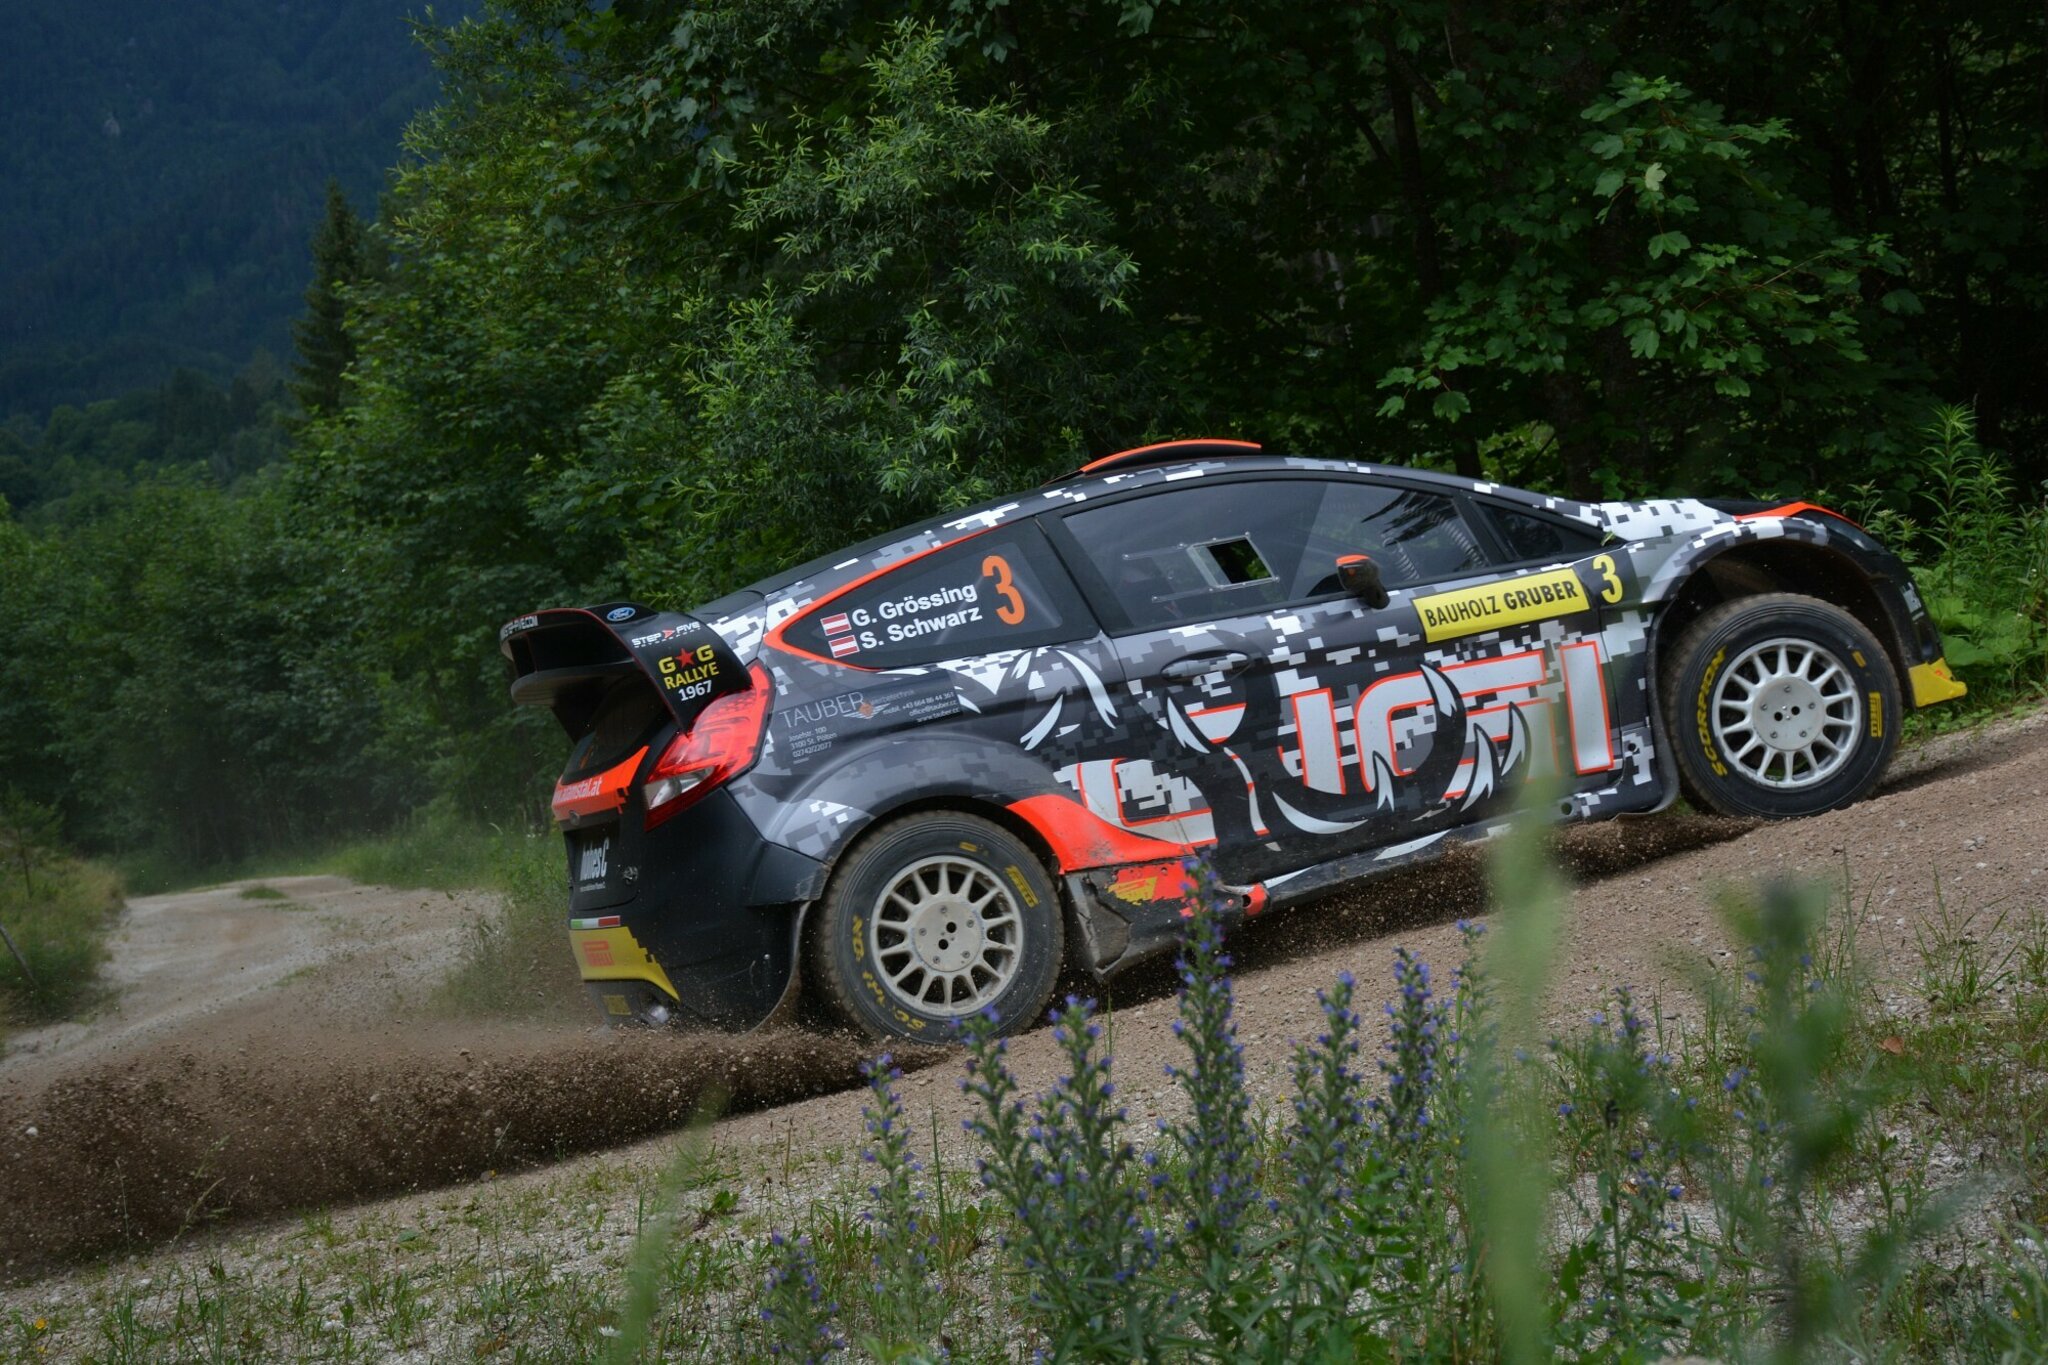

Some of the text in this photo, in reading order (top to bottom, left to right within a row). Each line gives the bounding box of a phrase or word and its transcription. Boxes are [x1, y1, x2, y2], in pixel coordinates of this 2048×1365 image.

[981, 554, 1025, 626] 3
[1592, 555, 1623, 604] 3
[852, 584, 978, 627] G. Grössing
[1424, 580, 1578, 628] BAUHOLZ GRUBER
[631, 621, 701, 646] STEP FIVE
[859, 606, 983, 649] S. Schwarz
[664, 661, 720, 690] RALLYE
[678, 680, 713, 702] 1967
[779, 691, 865, 728] TAUBER
[1697, 645, 1728, 777] SCORPION
